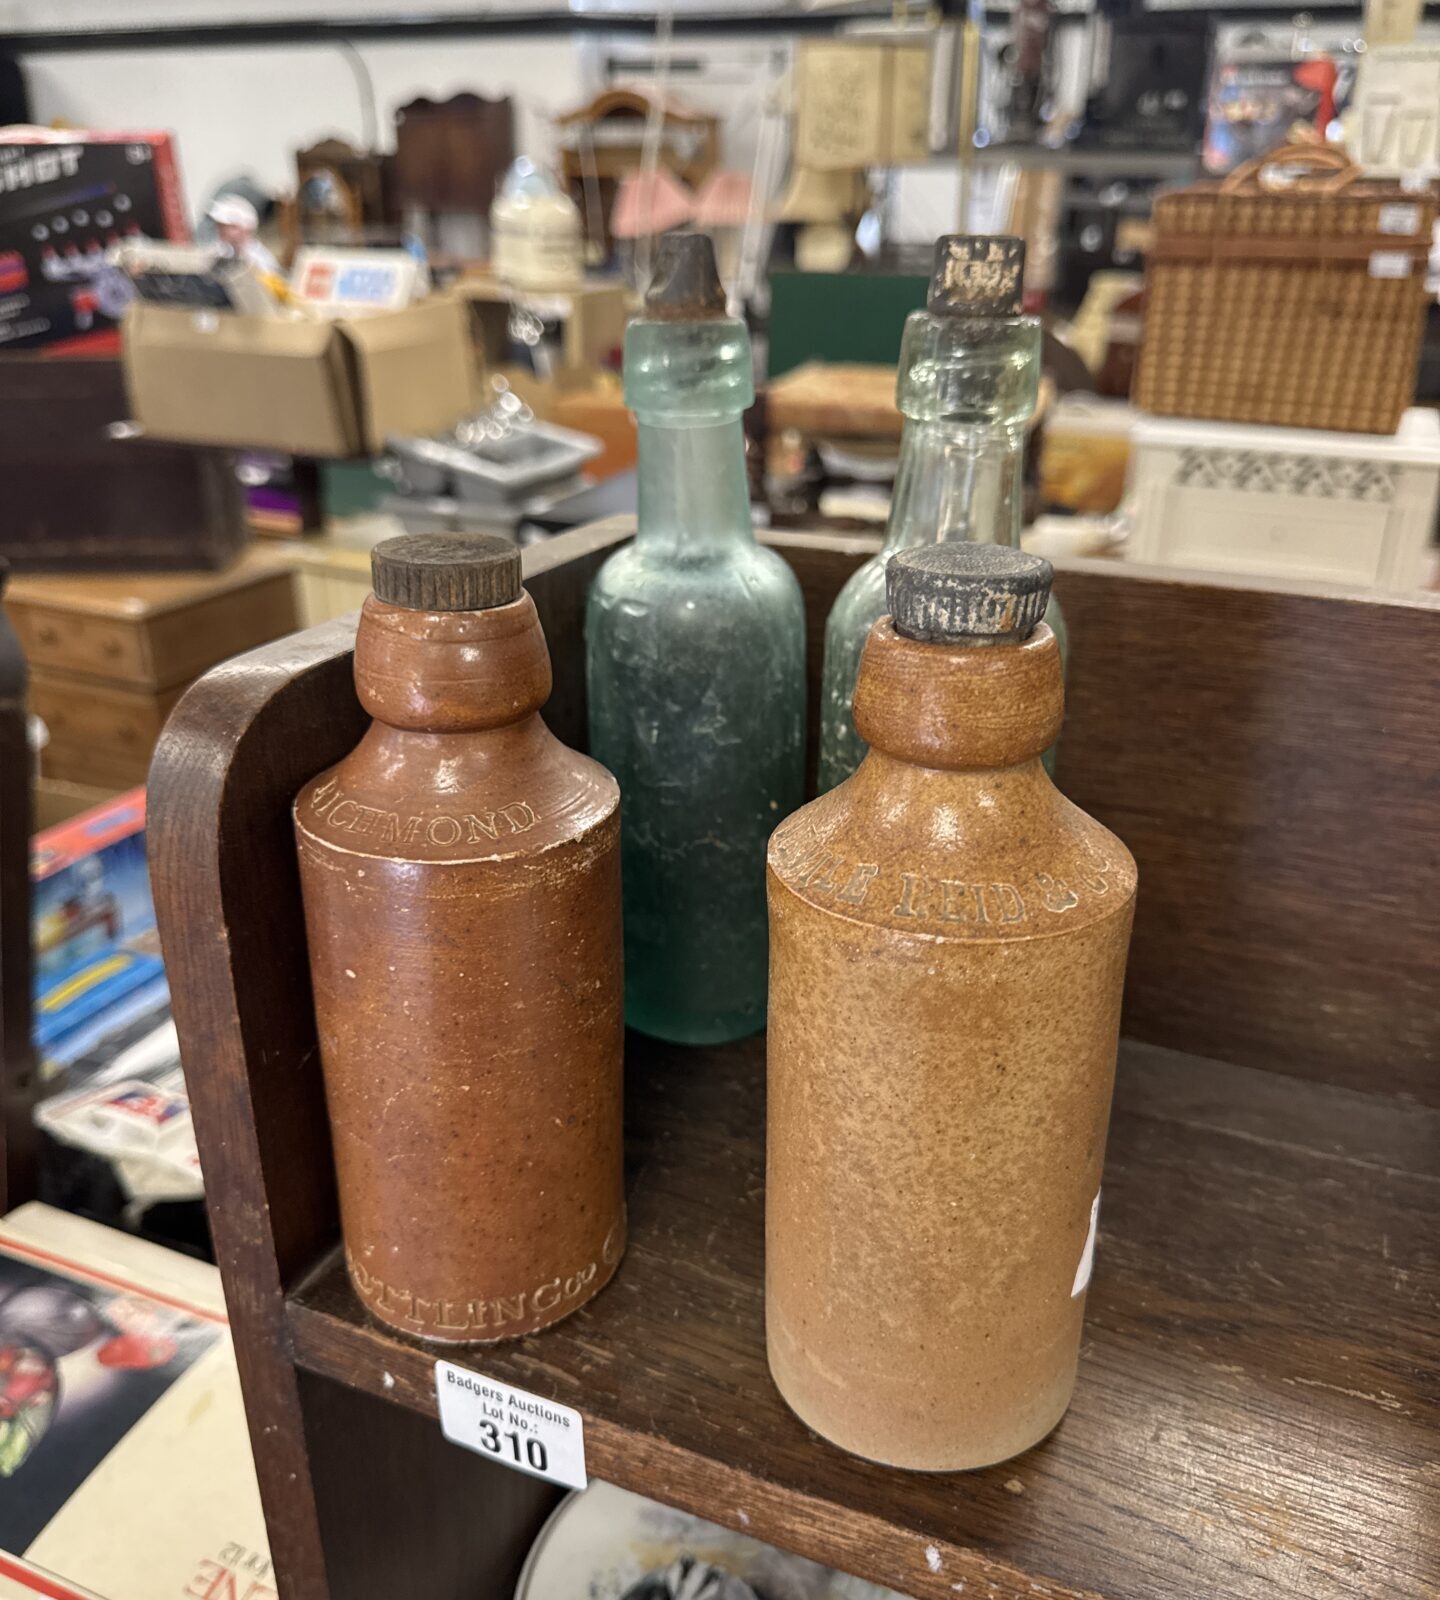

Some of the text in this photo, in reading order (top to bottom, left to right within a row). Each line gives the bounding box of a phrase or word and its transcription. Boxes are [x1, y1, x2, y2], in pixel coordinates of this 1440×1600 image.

[0, 145, 84, 194] HOT
[447, 1370, 571, 1428] Badgers Auctions
[482, 1402, 505, 1421] Lot
[479, 1419, 548, 1472] 310
